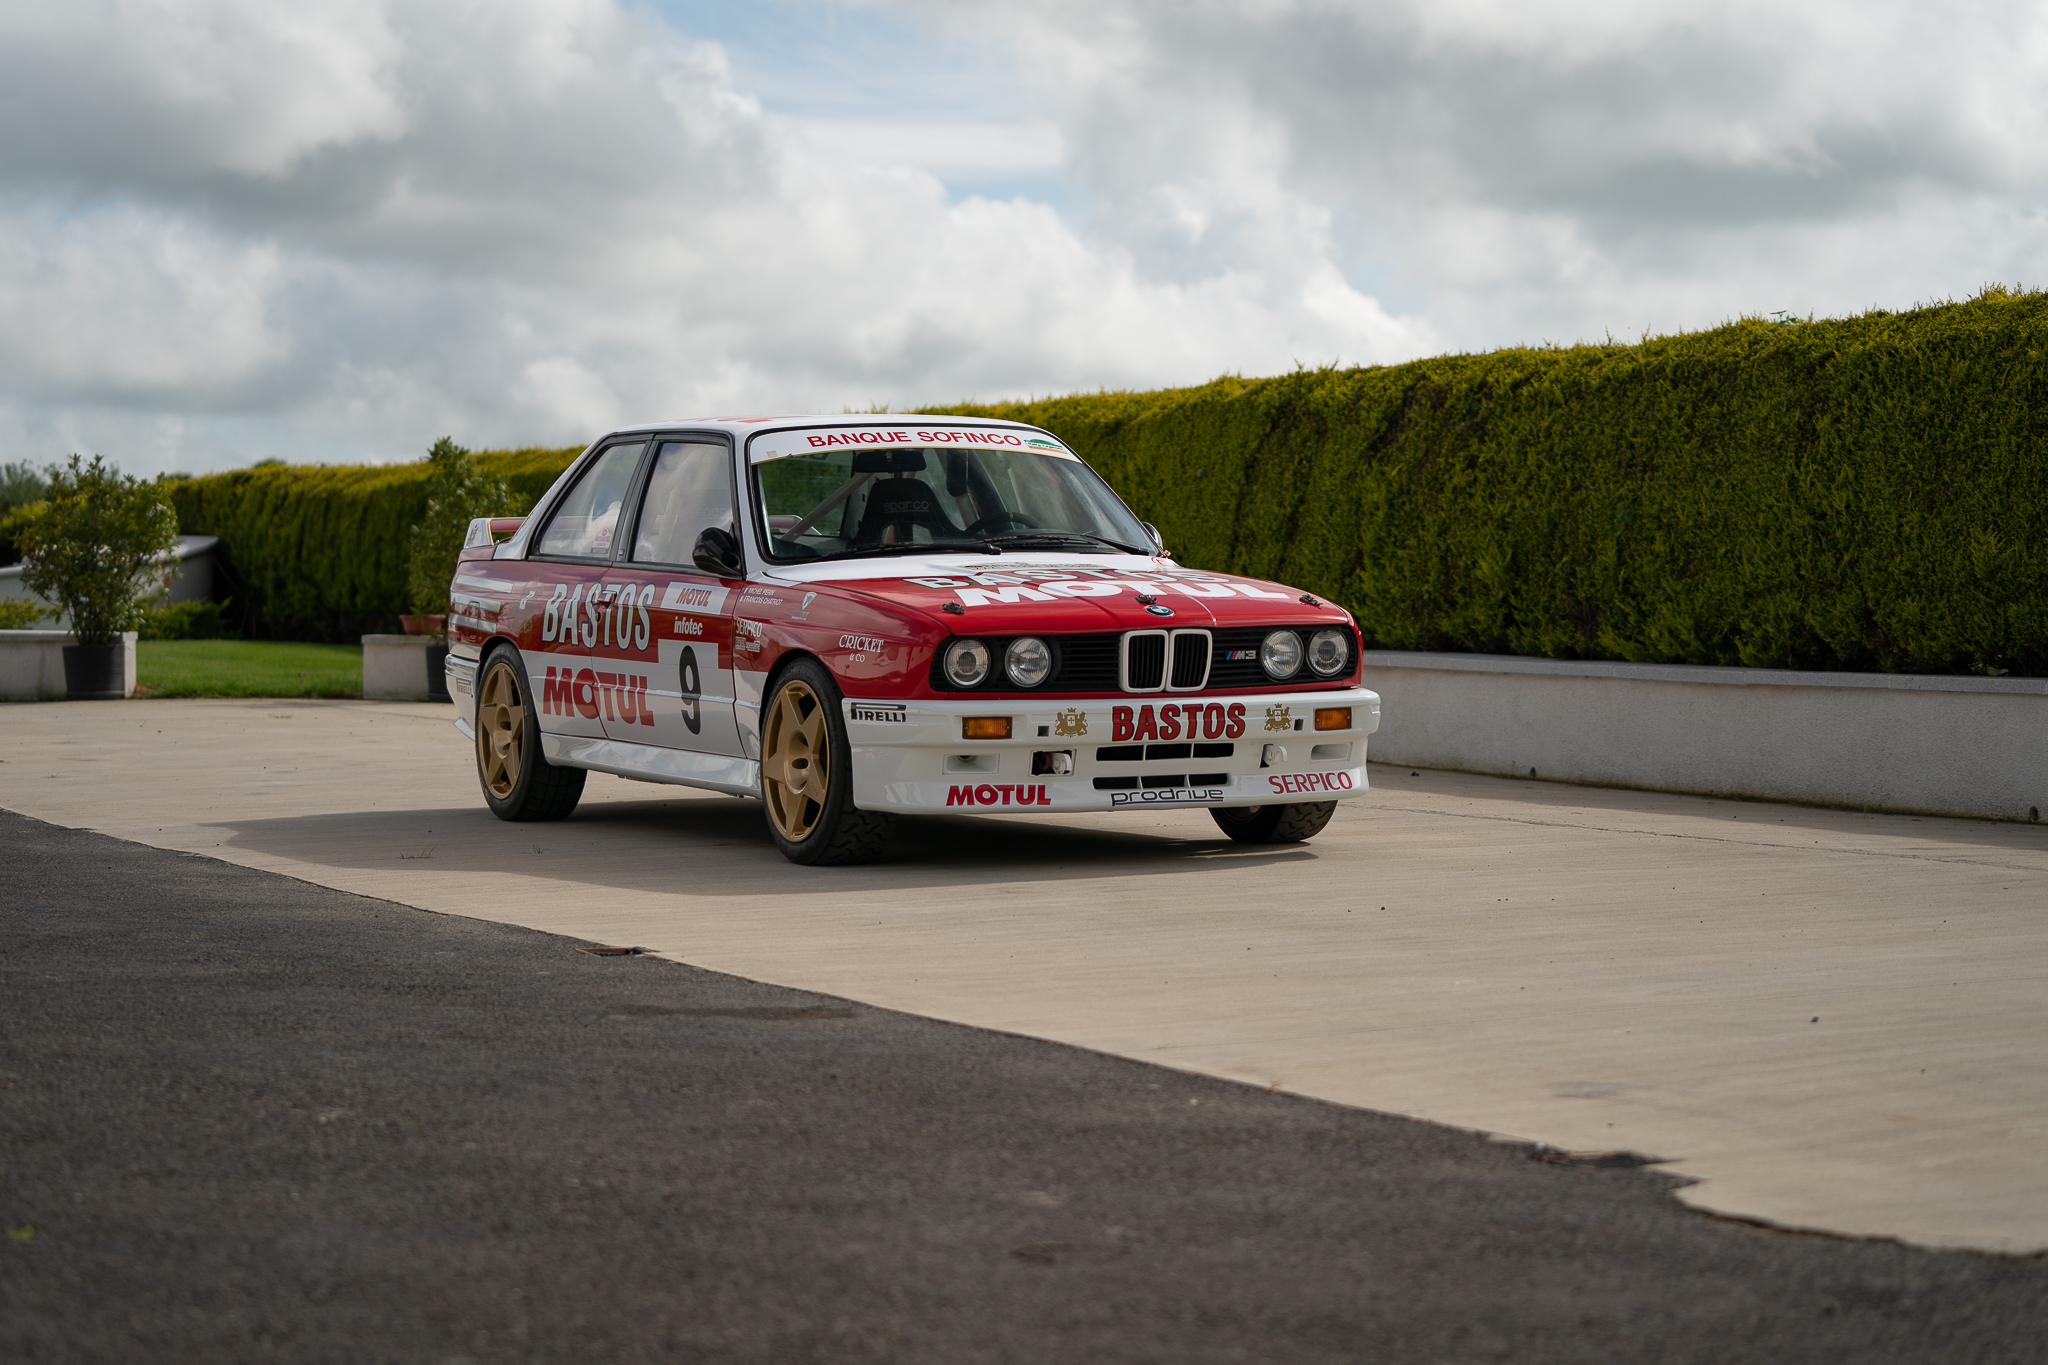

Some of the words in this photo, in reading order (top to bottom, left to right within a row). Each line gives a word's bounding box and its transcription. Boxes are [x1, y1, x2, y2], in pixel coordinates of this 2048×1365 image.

[807, 431, 910, 447] BANQUE
[917, 431, 1022, 446] SOFINCO
[883, 500, 930, 513] sparco
[675, 587, 712, 607] MOTUL
[953, 580, 1287, 606] MOTUL
[542, 582, 656, 651] BASTOS
[674, 616, 703, 636] infotec
[736, 617, 763, 638] SERPICO
[839, 634, 884, 653] CRICKET
[849, 653, 855, 662] &
[855, 654, 865, 663] CO
[1234, 650, 1257, 660] M3
[543, 666, 655, 727] MOTUL
[679, 645, 702, 735] 9
[851, 702, 906, 722] PIRELLI
[1112, 702, 1246, 741] BASTOS
[1268, 771, 1353, 795] SERPICO
[946, 784, 1052, 806] MOTUL
[1110, 788, 1224, 806] prodrive
